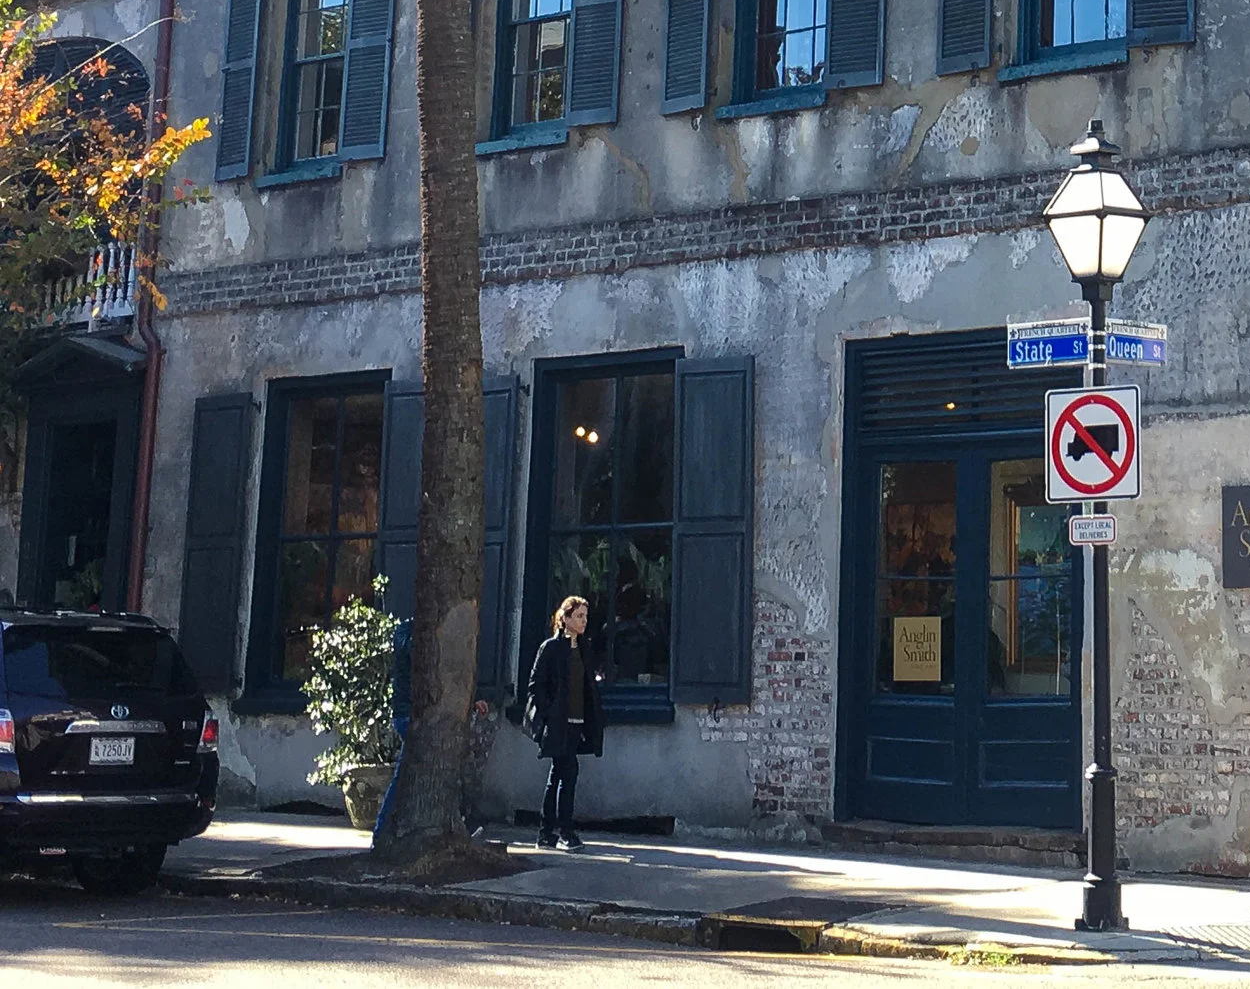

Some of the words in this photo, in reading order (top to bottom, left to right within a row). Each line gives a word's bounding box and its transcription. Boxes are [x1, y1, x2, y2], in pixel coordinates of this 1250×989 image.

[1019, 327, 1045, 338] FRENCH
[1015, 341, 1053, 362] State
[1072, 340, 1083, 354] St
[1109, 335, 1143, 359] Queen
[1153, 344, 1161, 358] St
[1074, 522, 1094, 530] EXCEPT
[1095, 521, 1112, 529] LOCAL
[1079, 531, 1108, 539] DELIVERIES
[899, 624, 936, 650] Anglin
[903, 643, 936, 662] Smith
